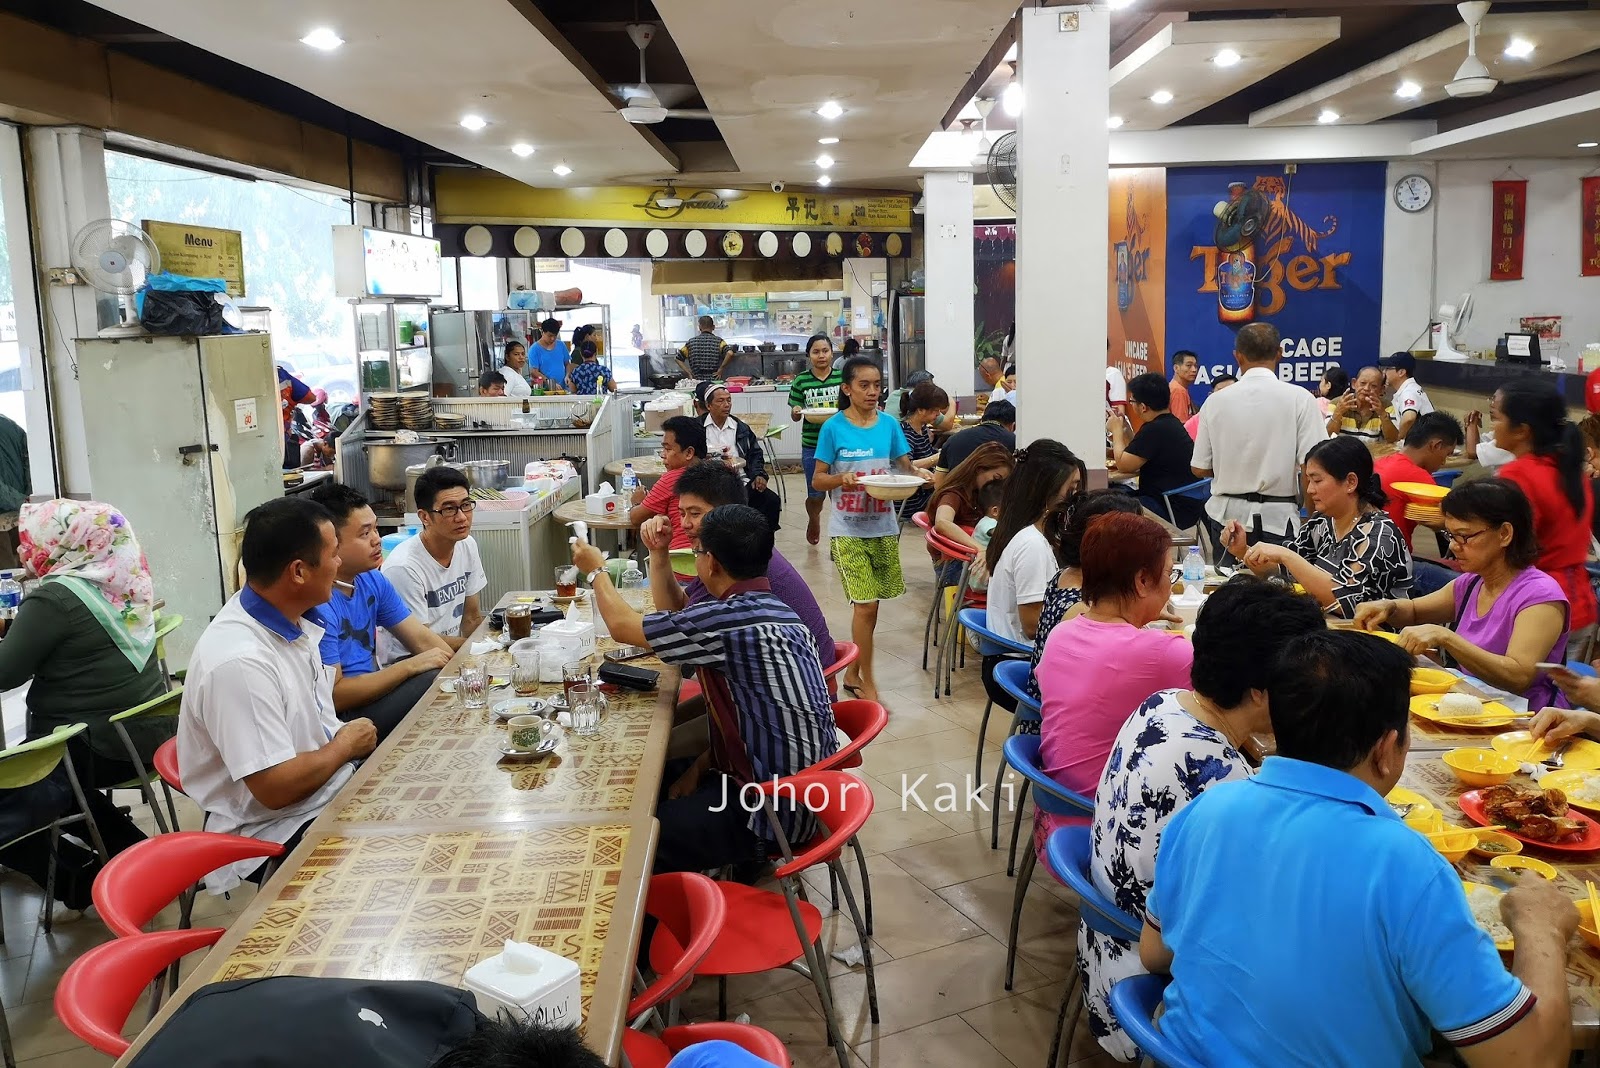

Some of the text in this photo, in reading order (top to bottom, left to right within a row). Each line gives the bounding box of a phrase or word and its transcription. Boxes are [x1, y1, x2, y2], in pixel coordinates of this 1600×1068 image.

[184, 233, 213, 247] Menu
[1124, 340, 1148, 361] UNCAGE
[1279, 337, 1343, 358] CAGE
